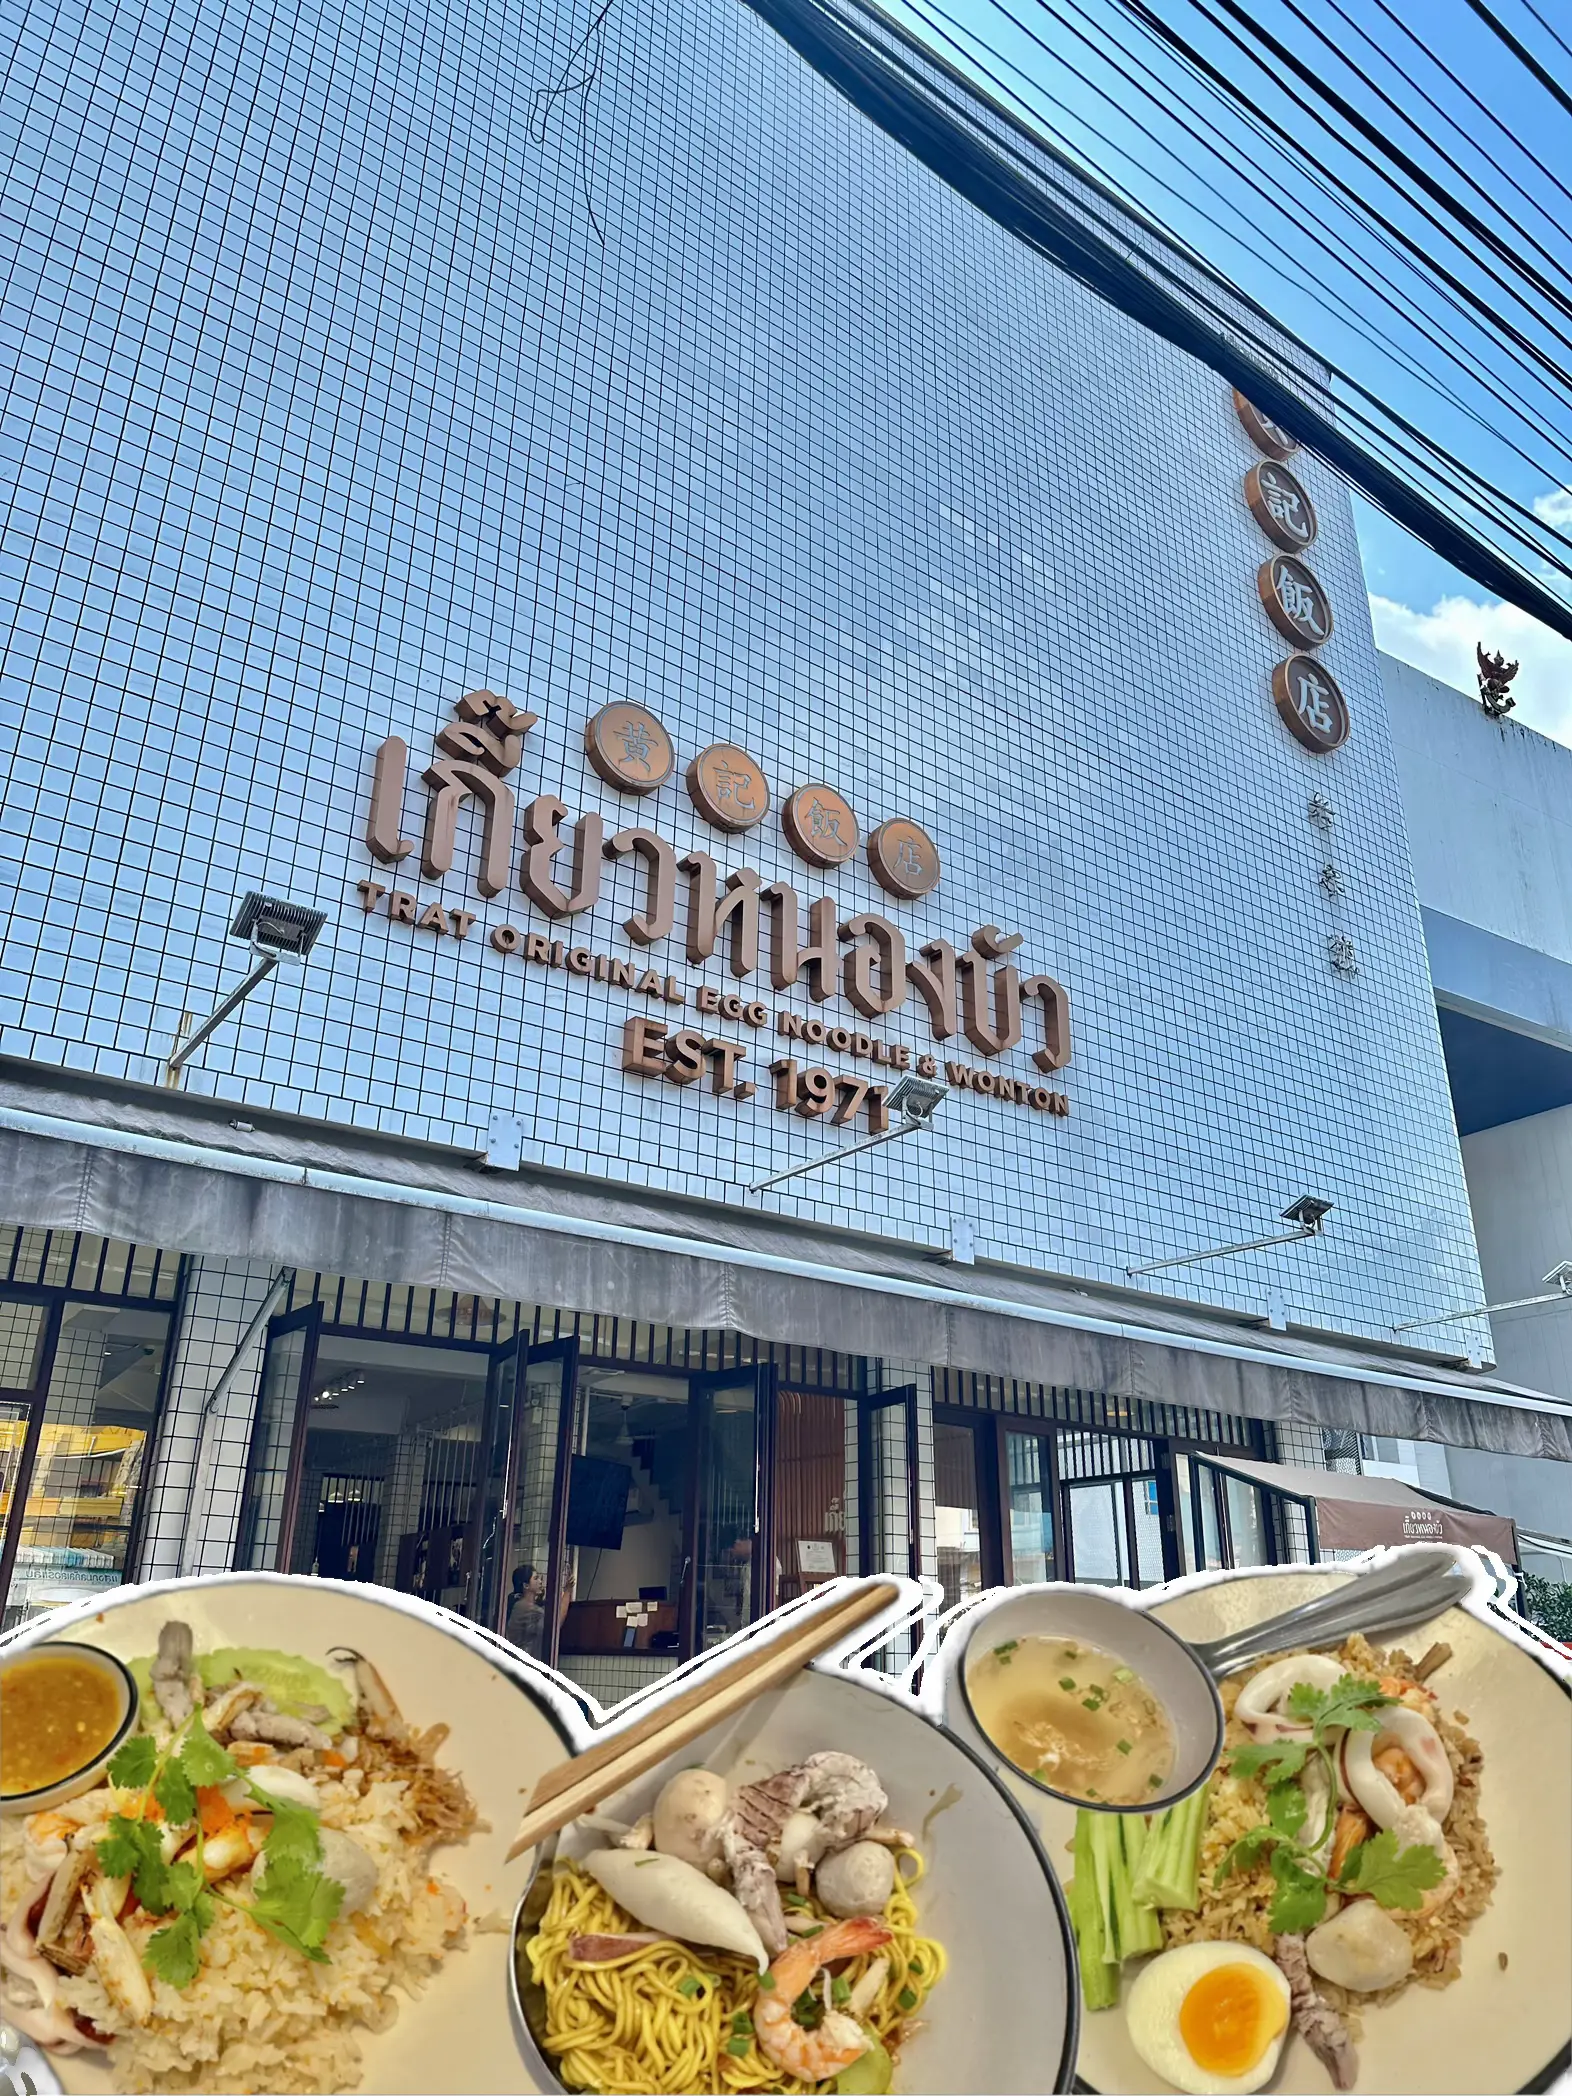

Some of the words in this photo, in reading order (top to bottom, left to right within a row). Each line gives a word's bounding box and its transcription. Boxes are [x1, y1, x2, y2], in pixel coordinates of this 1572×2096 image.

[357, 879, 476, 939] TRAT
[490, 924, 685, 1005] ORIGINAL
[696, 985, 768, 1028] EGG
[778, 1009, 911, 1071] NOODLE
[916, 1053, 937, 1078] &
[945, 1060, 1070, 1118] WONTON
[366, 688, 1071, 1074] เกี๊ยวหนองบัว
[622, 1015, 757, 1100] EST.
[769, 1058, 889, 1135] 1971
